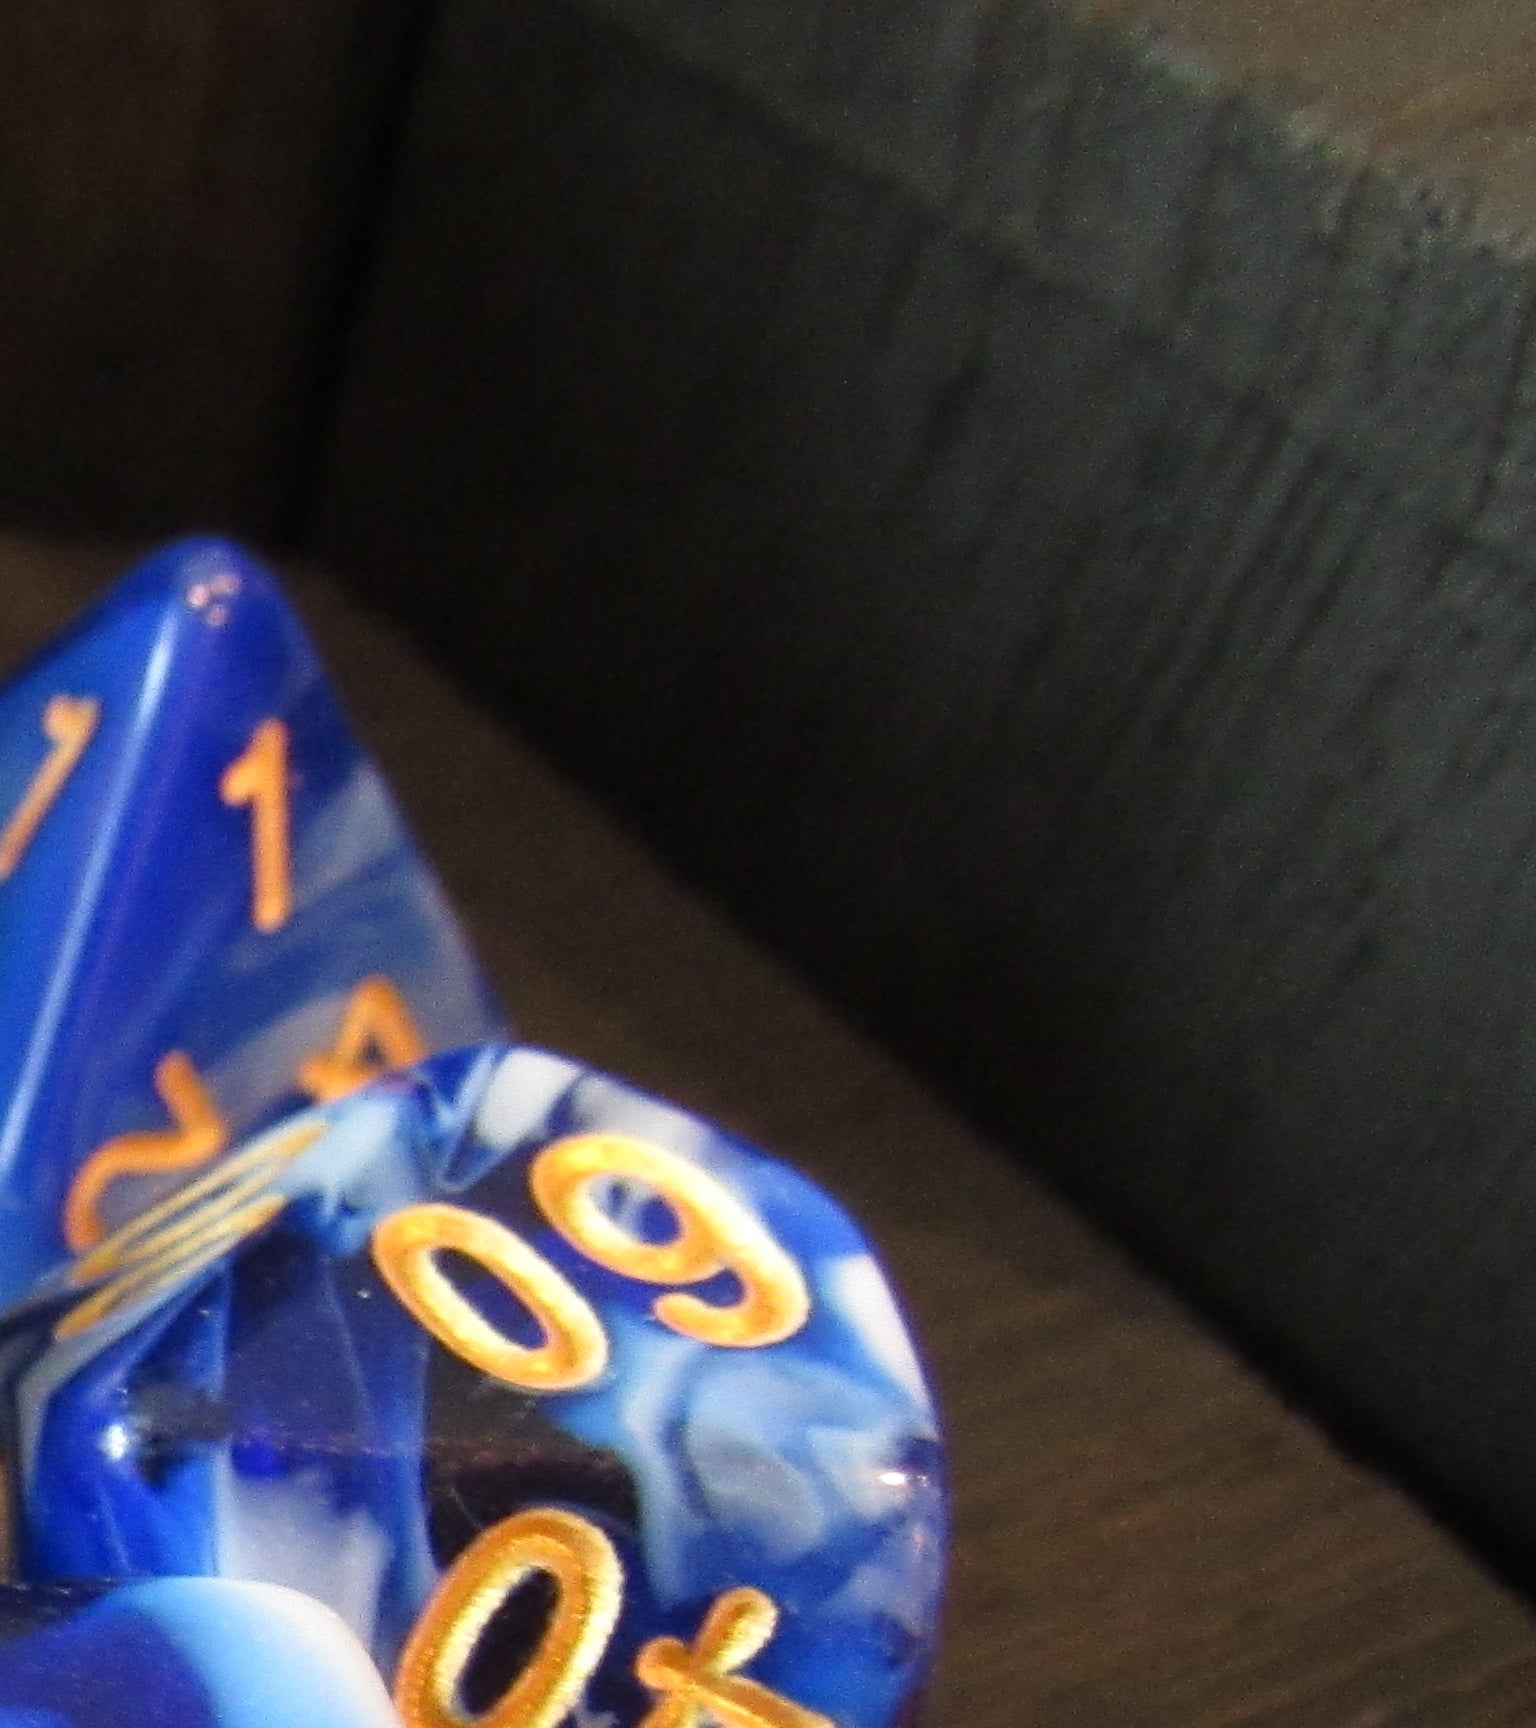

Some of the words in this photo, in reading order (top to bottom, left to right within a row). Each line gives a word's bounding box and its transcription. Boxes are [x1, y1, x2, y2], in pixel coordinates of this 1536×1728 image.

[218, 718, 295, 933] 1
[296, 976, 430, 1104] 4
[64, 1049, 228, 1256] 2
